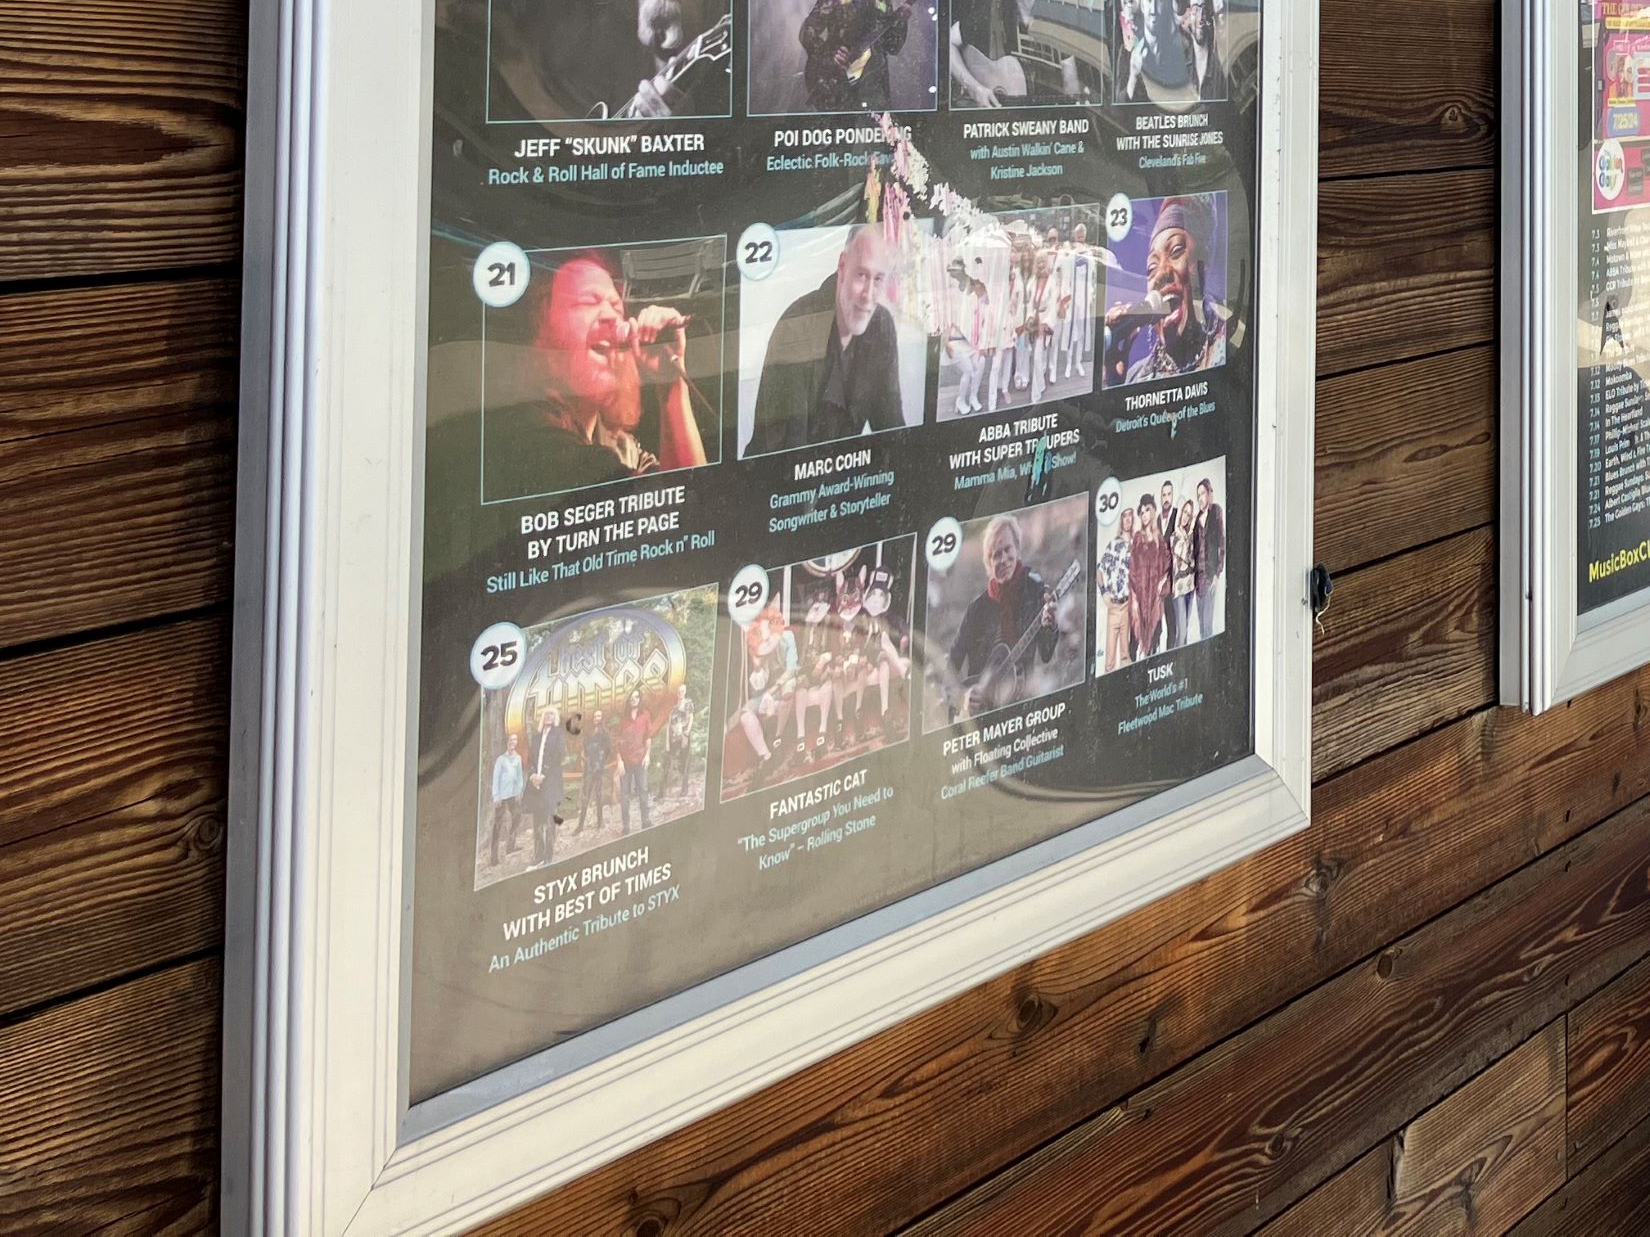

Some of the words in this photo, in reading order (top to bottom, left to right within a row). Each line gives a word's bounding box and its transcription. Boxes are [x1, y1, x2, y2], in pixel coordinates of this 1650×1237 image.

[963, 122, 1009, 139] PATRICK
[1012, 120, 1057, 136] SWEANY
[1059, 119, 1089, 134] BAND
[1135, 115, 1176, 131] BEATLES
[1177, 113, 1208, 129] BRUNCH
[514, 138, 561, 159] JEFF
[641, 134, 705, 153] BAXTER
[774, 130, 799, 148] POI
[802, 128, 832, 146] DOG
[1116, 136, 1141, 151] WITH
[1142, 135, 1161, 150] THE
[1162, 133, 1199, 148] SUNRISE
[488, 166, 528, 186] Rock
[532, 166, 544, 184] &
[549, 165, 577, 182] Roll
[581, 163, 608, 181] Hall
[611, 163, 626, 180] of
[628, 161, 666, 179] Fame
[669, 159, 724, 177] Inductee
[1110, 208, 1128, 227] 23
[744, 241, 773, 264] 22
[487, 262, 516, 287] 21
[1125, 387, 1183, 411] THORNETTA
[1184, 381, 1208, 401] DAVIS
[979, 425, 1011, 443] ABBA
[1013, 413, 1058, 437] TRIBUTE
[949, 451, 981, 470] WITH
[984, 442, 1023, 463] SUPER
[1025, 429, 1080, 454] TRUPERS
[794, 458, 833, 481] MARC
[835, 449, 871, 472] COHN
[770, 488, 816, 510] Grammy
[818, 470, 895, 499] Award-Winning
[1099, 491, 1119, 512] 30
[521, 511, 559, 534] BOB
[564, 500, 615, 526] SEGER
[618, 485, 686, 514] TRIBUTE
[527, 538, 553, 560] BY
[556, 528, 600, 554] TURN
[604, 521, 633, 543] THE
[637, 512, 680, 536] PAGE
[931, 533, 957, 558] 29
[735, 581, 762, 608] 29
[481, 641, 518, 672] 25
[1147, 663, 1174, 684] TUSK
[942, 731, 981, 756] PETER
[983, 717, 1024, 743] MAYER
[1025, 702, 1066, 728] GROUP
[769, 779, 842, 820] FANTASTIC
[843, 769, 868, 793] CAT
[533, 872, 579, 904] STYX
[581, 846, 650, 886] BRUNCH
[503, 907, 551, 941] WITH
[554, 891, 595, 924] BEST
[599, 885, 620, 905] OF
[624, 863, 672, 896] TIMES
